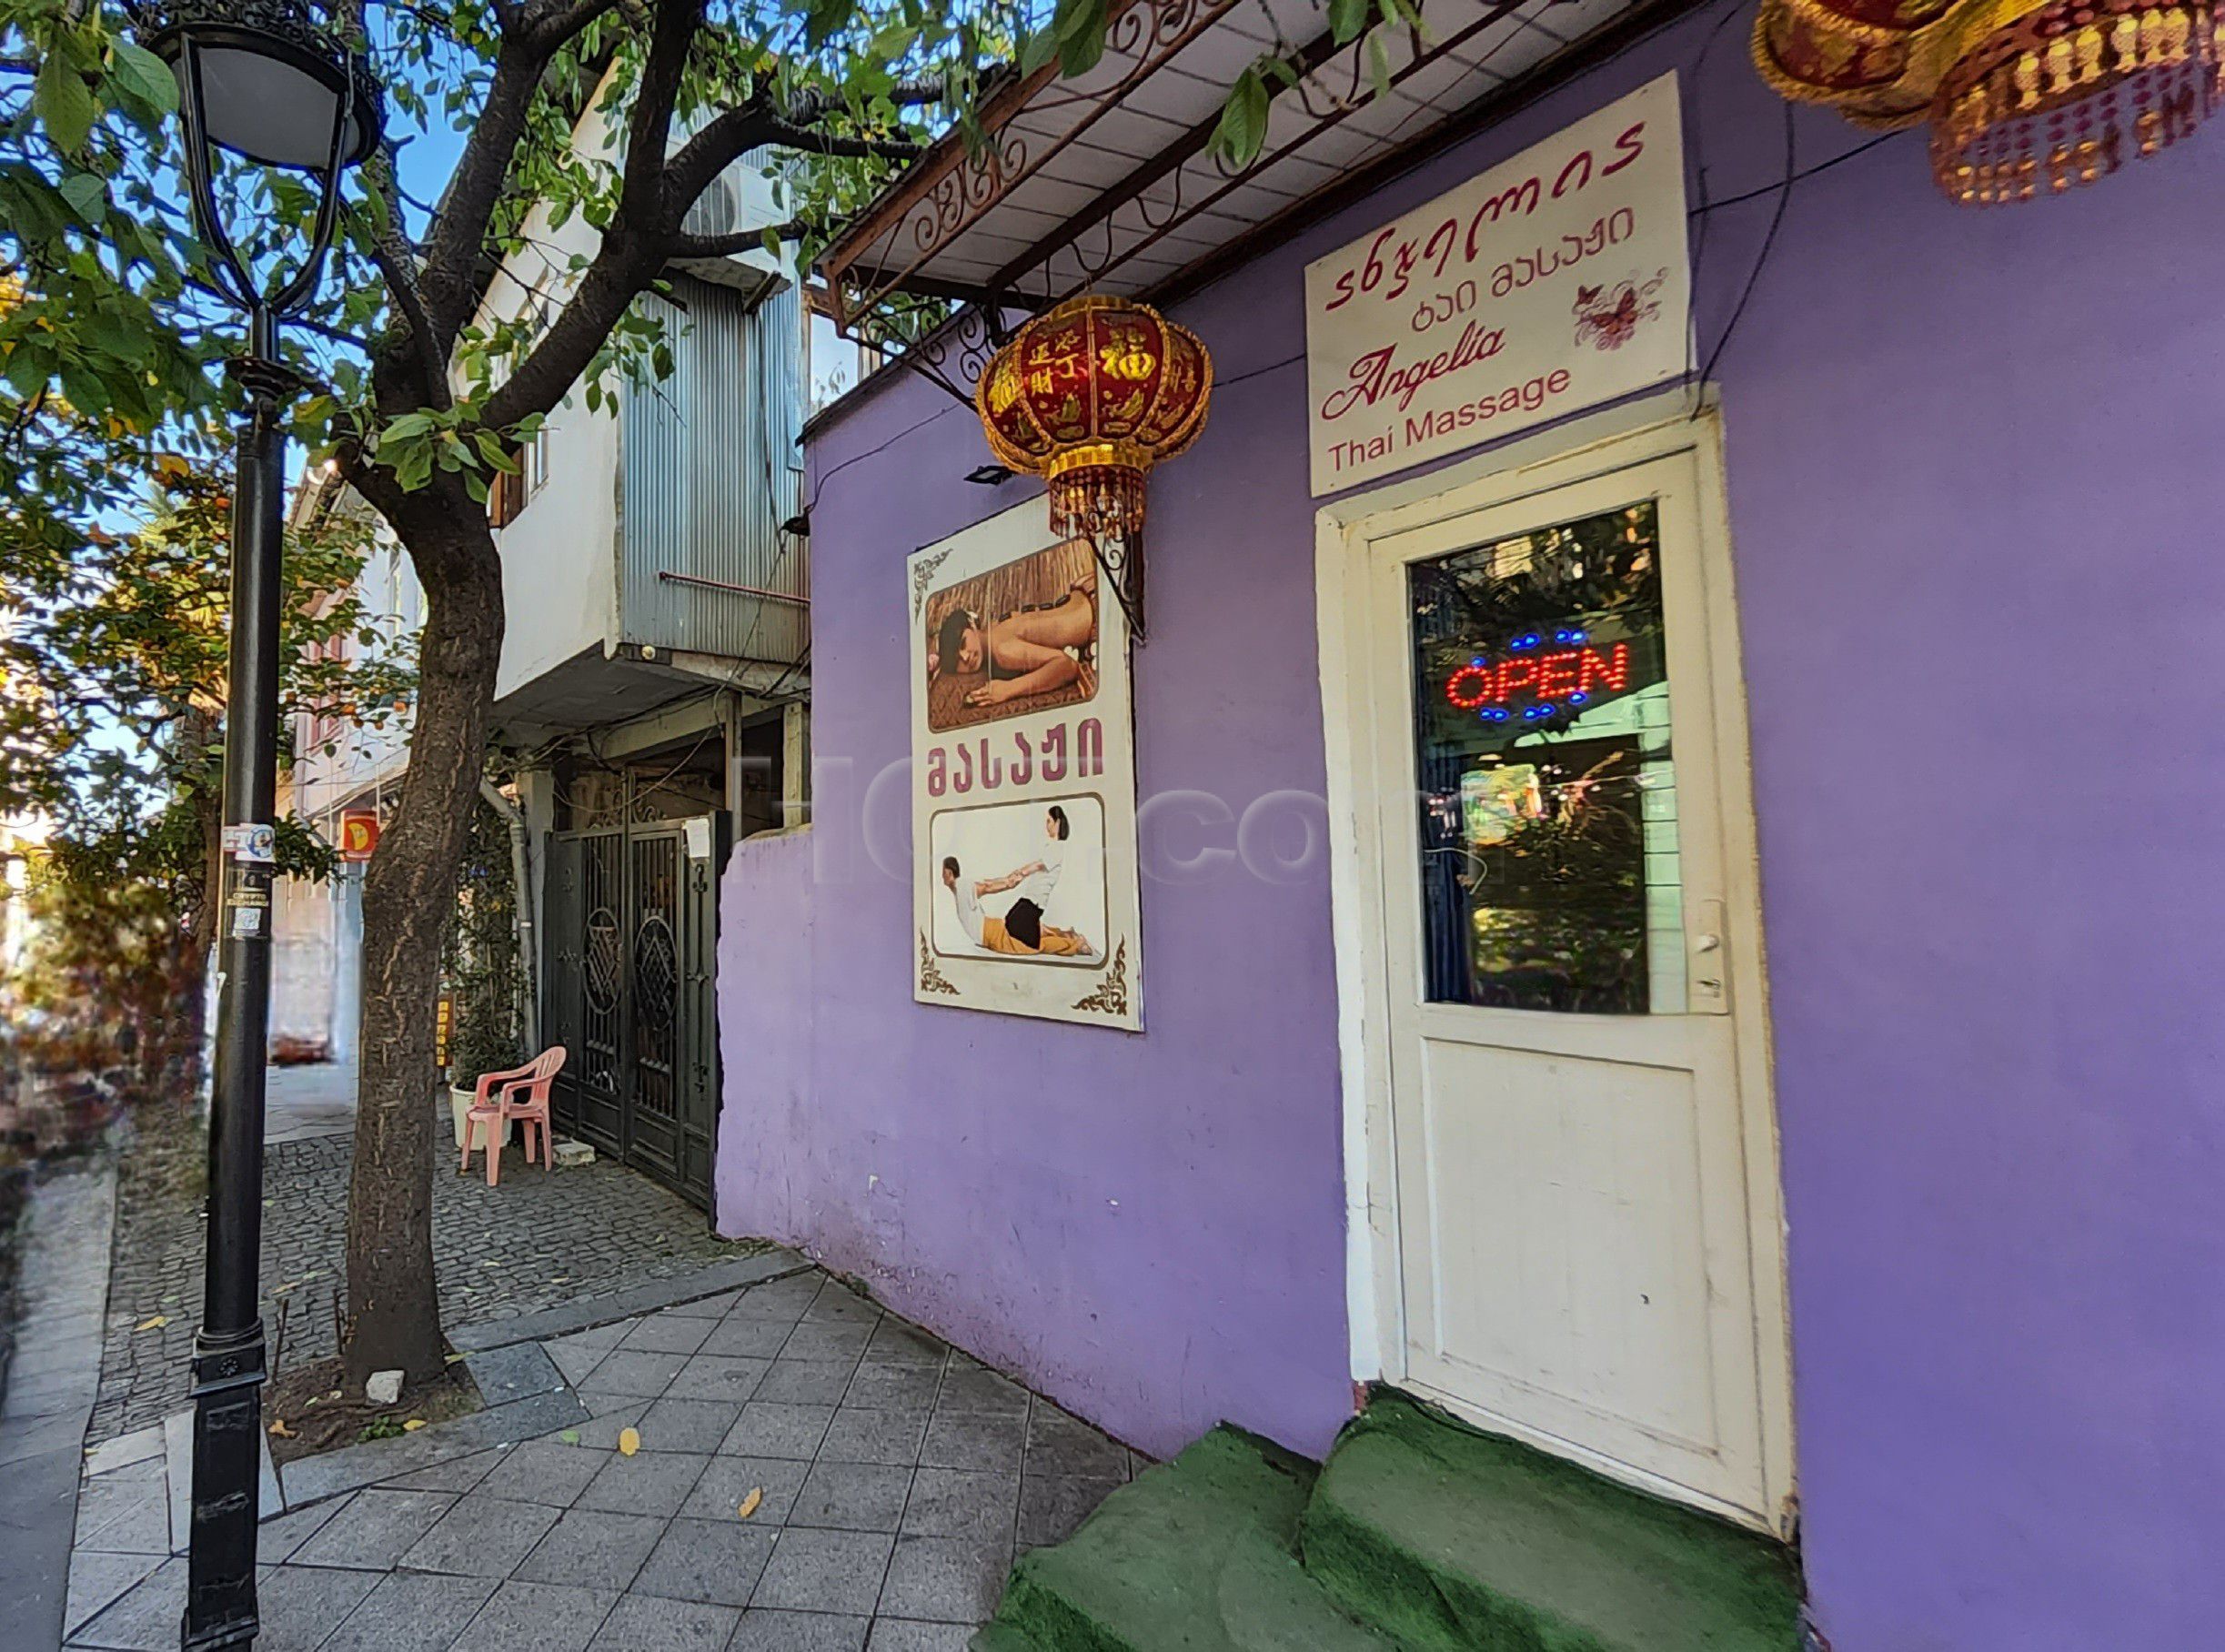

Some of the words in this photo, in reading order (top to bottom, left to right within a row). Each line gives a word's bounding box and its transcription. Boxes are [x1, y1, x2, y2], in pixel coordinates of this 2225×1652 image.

[1411, 279, 1477, 332] ტაი
[1492, 207, 1635, 297] მასაჟი
[1321, 318, 1506, 420] Angelia
[1328, 425, 1394, 471] Thai
[1405, 368, 1571, 448] Massage
[1445, 642, 1629, 710] OPEN
[927, 717, 1104, 797] მასაჟი
